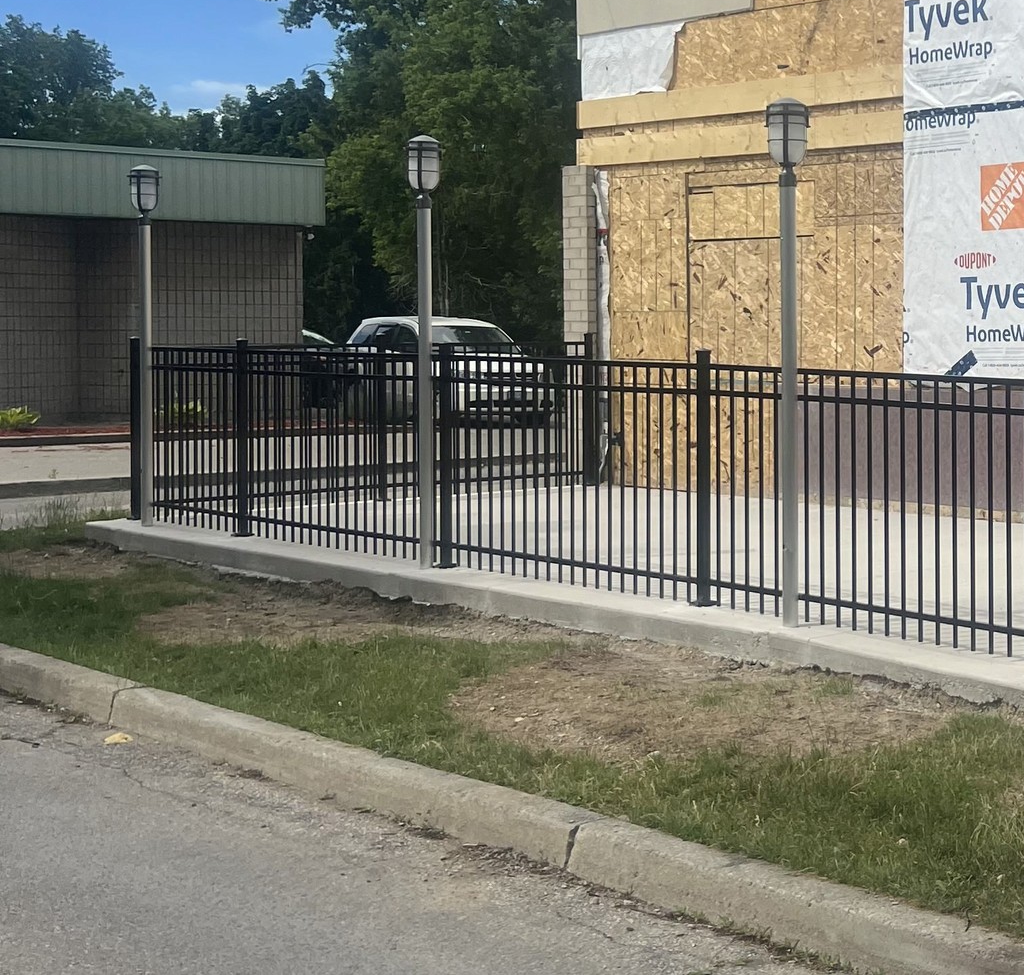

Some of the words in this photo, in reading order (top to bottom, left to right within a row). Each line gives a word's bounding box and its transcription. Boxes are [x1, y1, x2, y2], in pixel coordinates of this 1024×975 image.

[908, 40, 993, 65] HomeWrap
[904, 112, 976, 131] omeWrap
[959, 251, 992, 269] DUPONT
